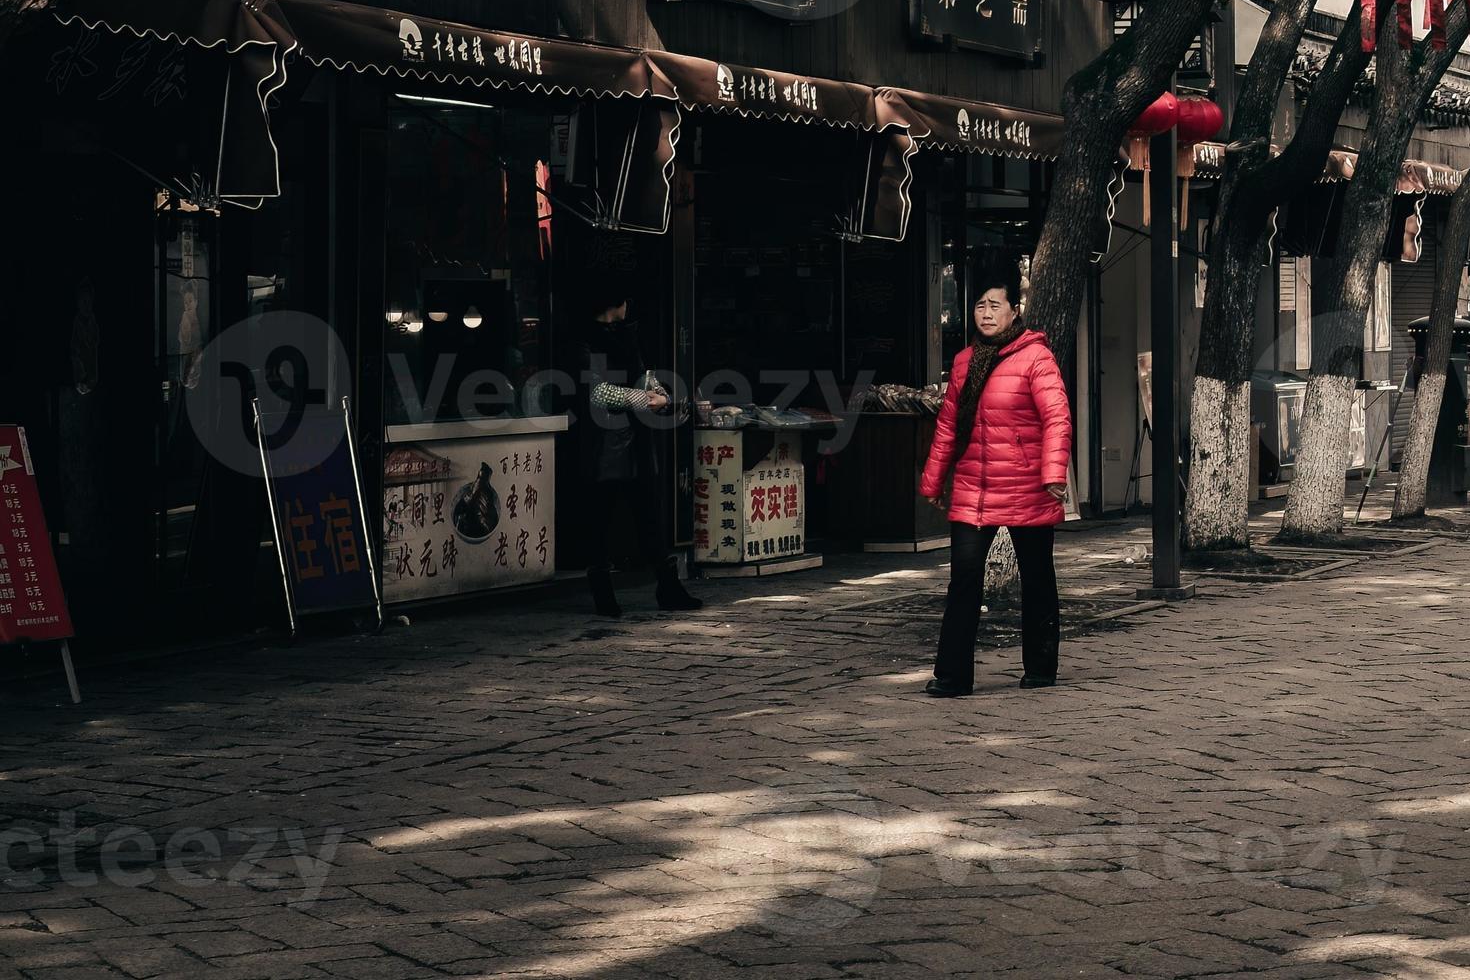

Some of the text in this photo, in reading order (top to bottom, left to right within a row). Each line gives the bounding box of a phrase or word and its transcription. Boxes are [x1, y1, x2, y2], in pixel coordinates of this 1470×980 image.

[698, 445, 734, 465] 特产
[759, 468, 790, 480] 百年老店
[751, 484, 798, 523] 芡实糕
[284, 491, 361, 583] 住宿
